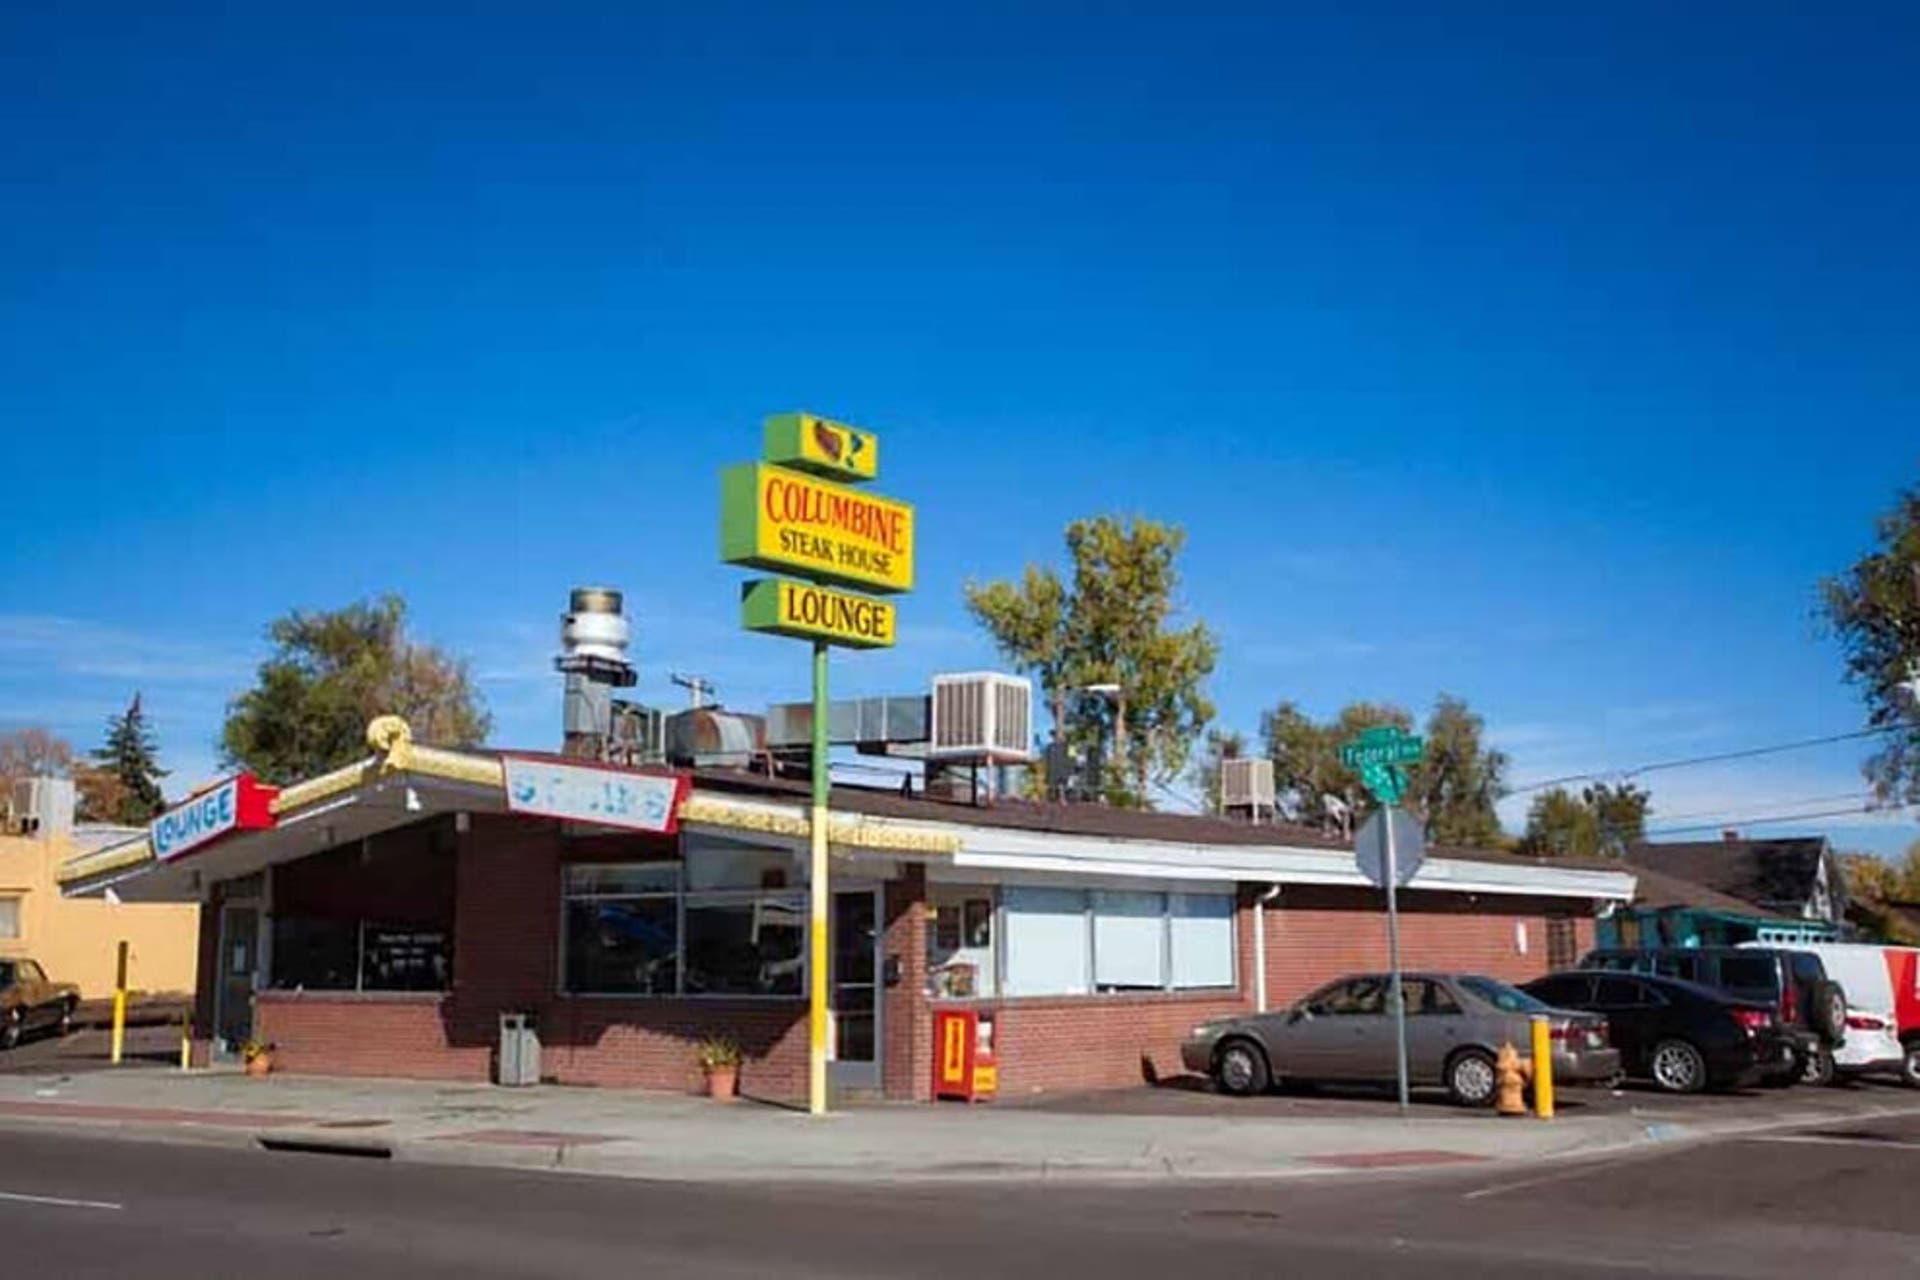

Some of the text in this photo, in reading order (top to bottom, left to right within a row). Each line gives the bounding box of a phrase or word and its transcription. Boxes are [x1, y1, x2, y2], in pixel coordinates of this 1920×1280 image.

[765, 477, 905, 555] COLUMBINE
[779, 528, 894, 576] STEAK HOUSE
[786, 586, 886, 638] LOUNGE
[155, 786, 234, 854] LOUNGE
